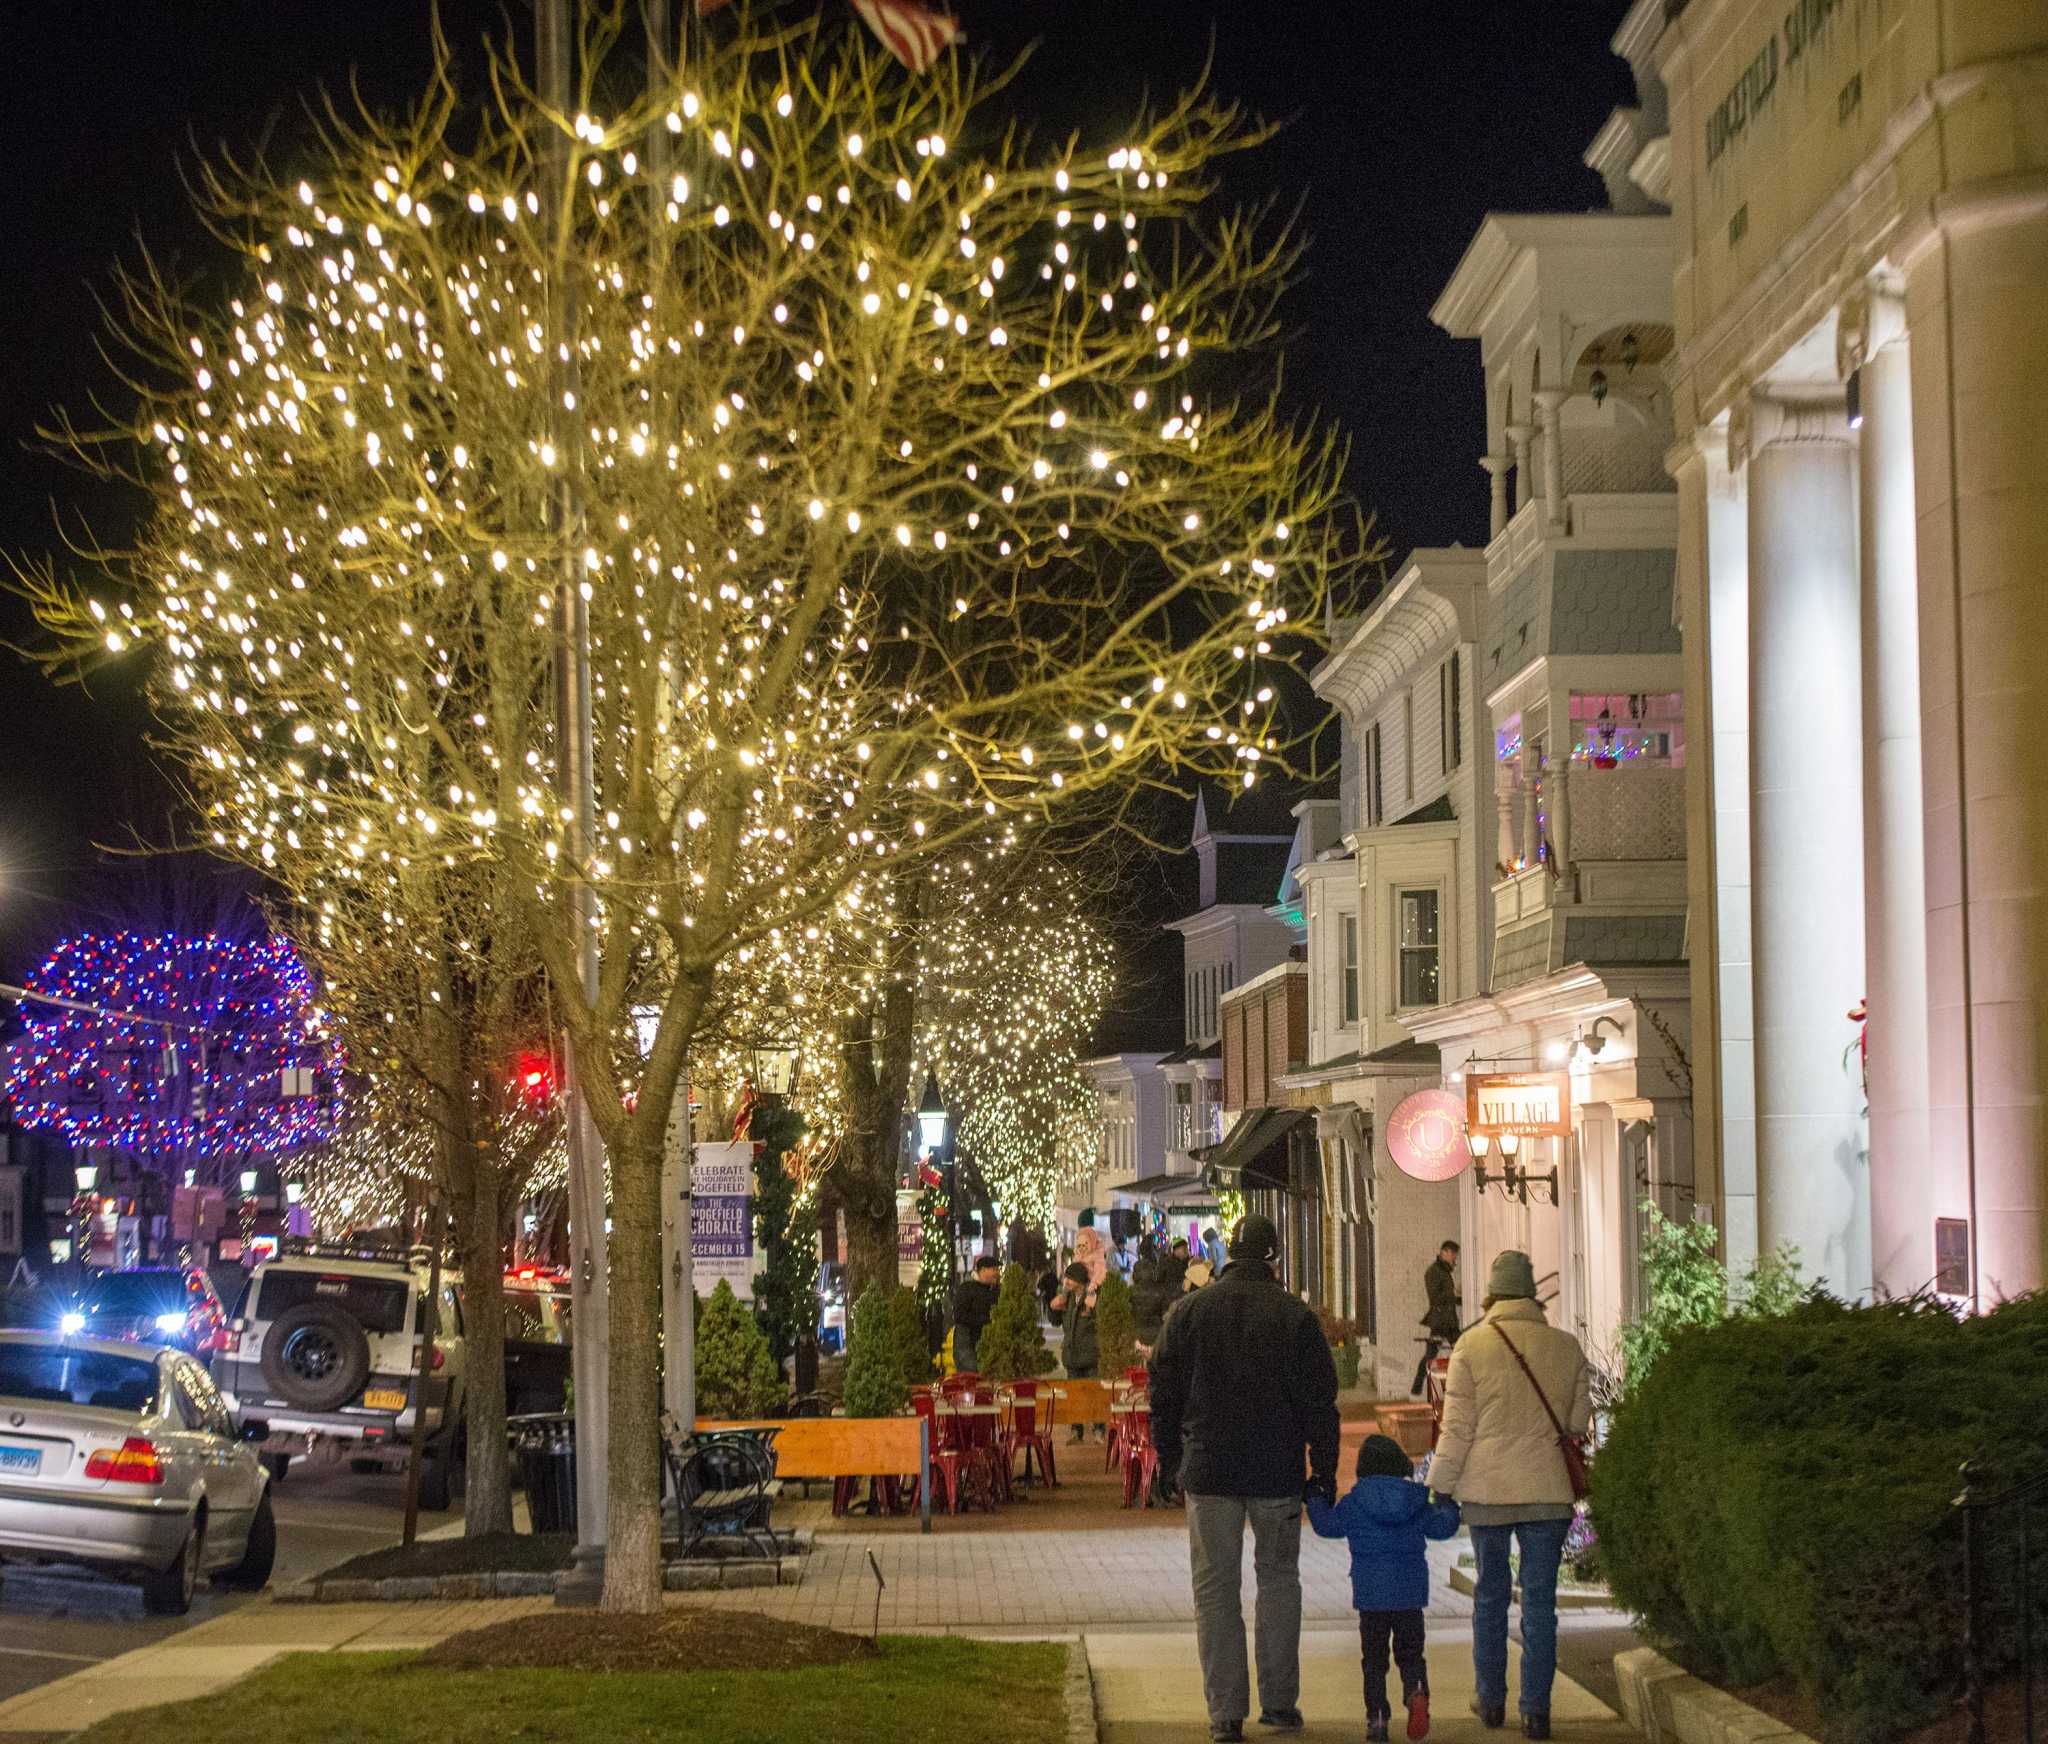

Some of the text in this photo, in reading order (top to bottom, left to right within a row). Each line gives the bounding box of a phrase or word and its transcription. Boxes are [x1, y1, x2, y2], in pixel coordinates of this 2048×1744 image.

[1483, 1102, 1556, 1124] VILLAGE
[693, 1166, 745, 1176] ELEBRATE
[694, 1183, 745, 1193] DGEFIELD
[709, 1199, 722, 1208] THE
[692, 1244, 745, 1255] ECEMBER 15
